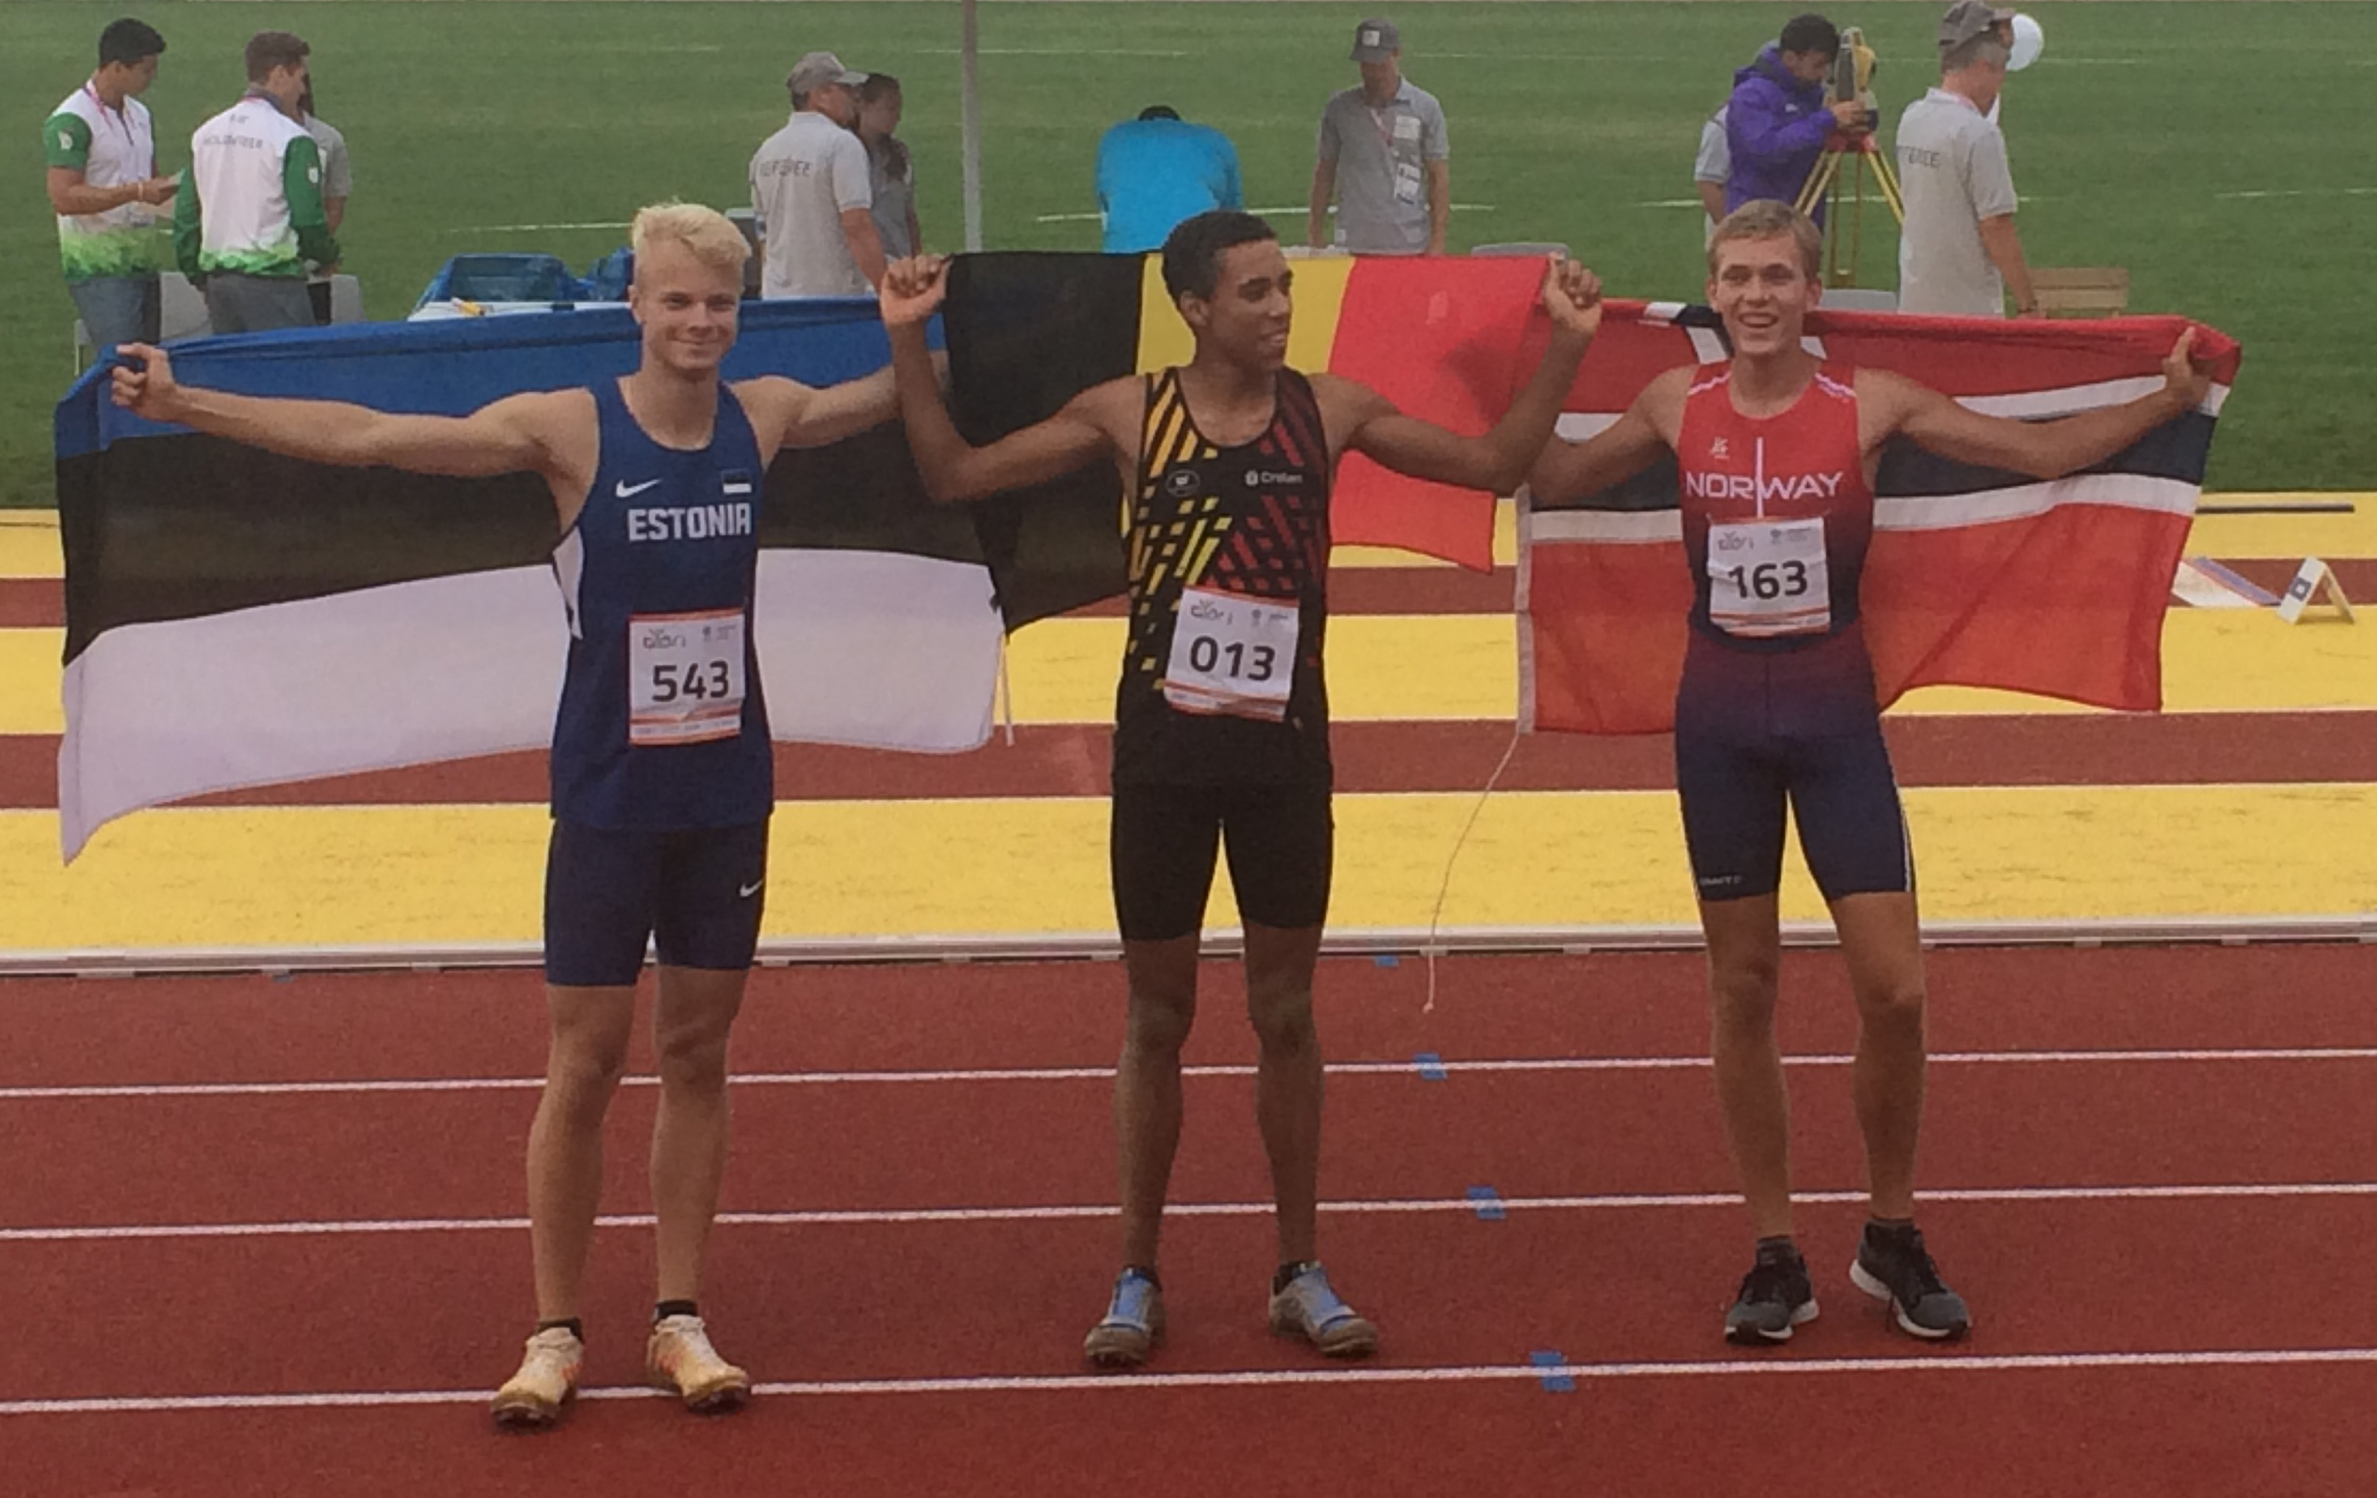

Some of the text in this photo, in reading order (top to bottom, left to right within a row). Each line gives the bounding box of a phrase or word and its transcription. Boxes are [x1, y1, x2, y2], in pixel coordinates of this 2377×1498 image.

[1686, 471, 1844, 499] NORWAY
[628, 503, 752, 542] ESTONIA
[1728, 560, 1808, 600] 163
[1190, 636, 1276, 681] 013
[652, 660, 730, 703] 543
